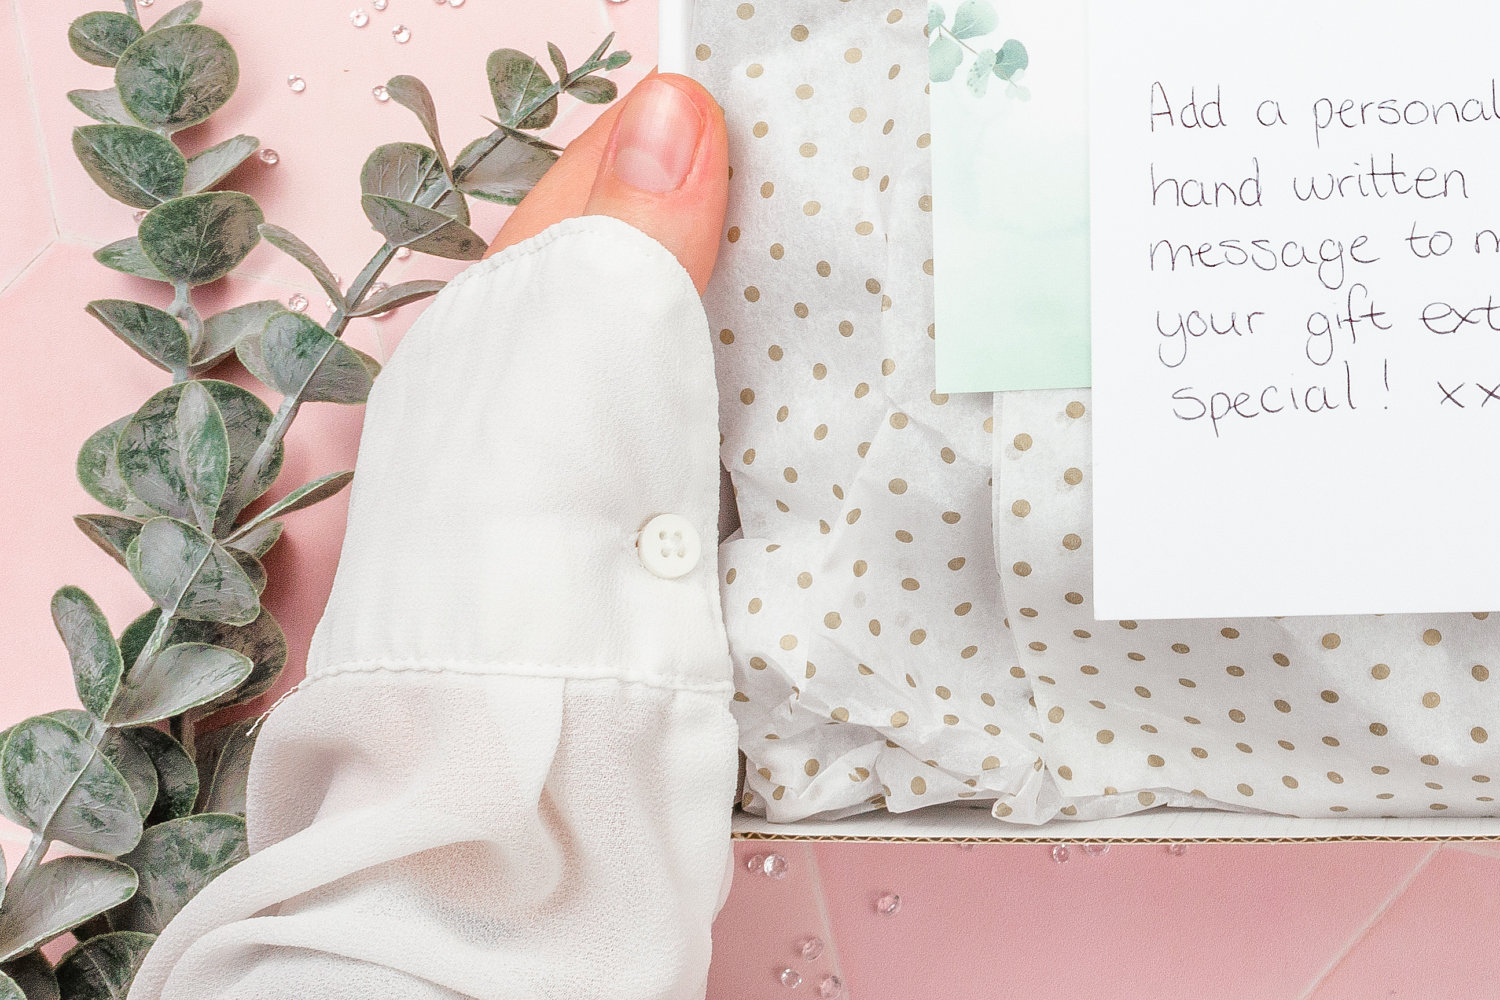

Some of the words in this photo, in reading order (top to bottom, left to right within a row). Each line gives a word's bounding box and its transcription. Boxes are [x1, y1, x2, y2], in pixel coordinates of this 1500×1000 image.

[1150, 81, 1227, 132] Add
[1256, 98, 1288, 128] a
[1150, 156, 1263, 208] hand
[1293, 153, 1469, 202] written
[1149, 234, 1381, 290] message
[1404, 220, 1454, 259] to
[1156, 309, 1265, 369] your
[1306, 283, 1393, 366] gift
[1171, 358, 1390, 439] special!
